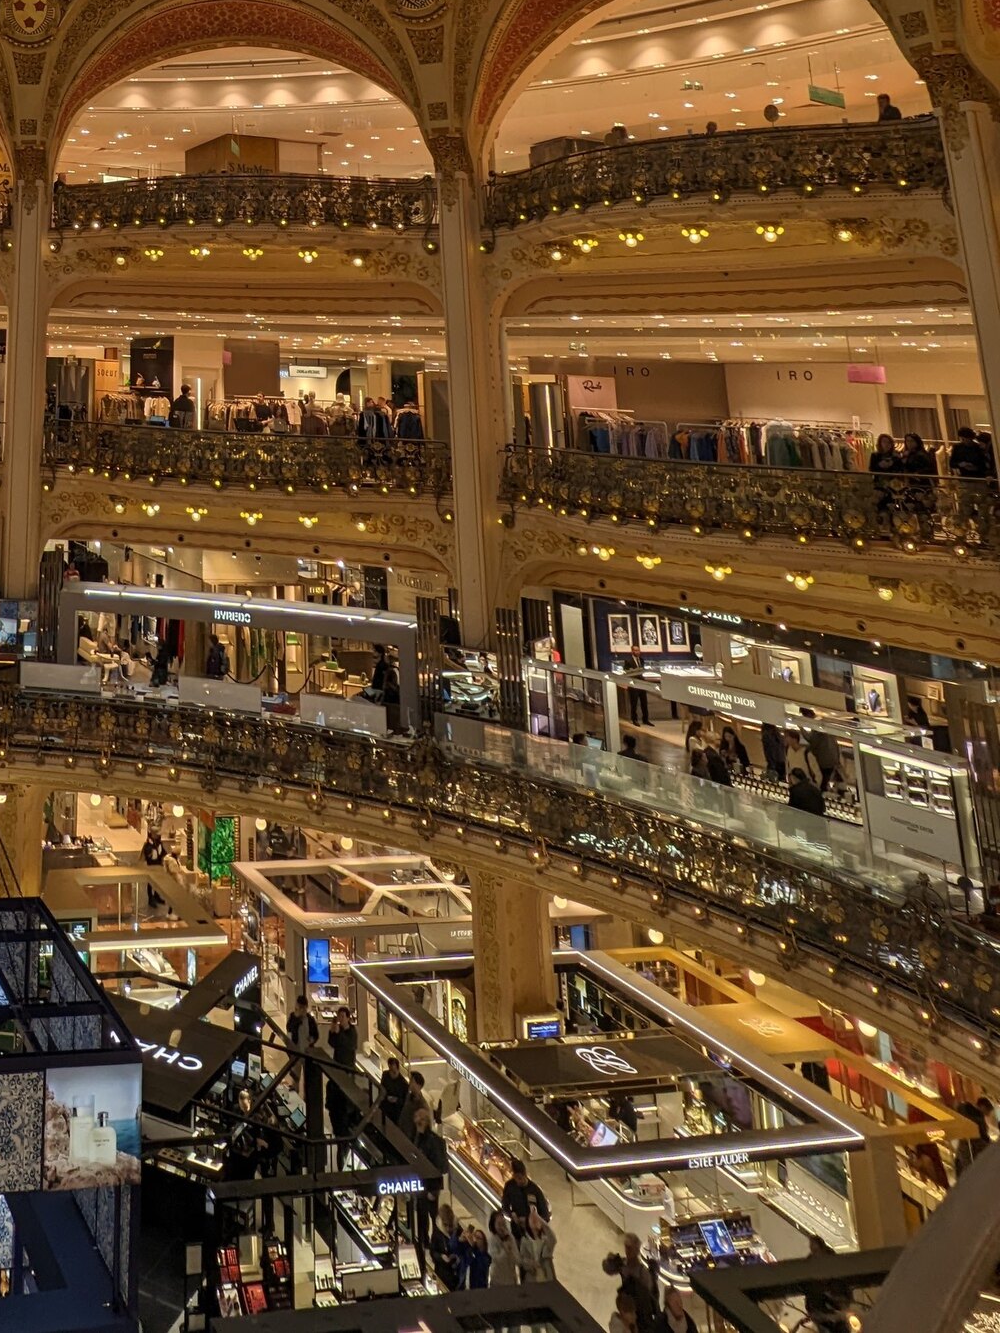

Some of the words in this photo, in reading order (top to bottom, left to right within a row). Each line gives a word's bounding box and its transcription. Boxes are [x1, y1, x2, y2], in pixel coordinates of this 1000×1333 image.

[214, 610, 251, 623] BYREDO
[688, 685, 733, 703] CHRISTIAN
[733, 695, 757, 709] DIOR
[713, 699, 732, 709] PARIS
[234, 966, 259, 998] CHANEL
[714, 1152, 750, 1167] LAUDER
[379, 1180, 424, 1194] CHANEL
